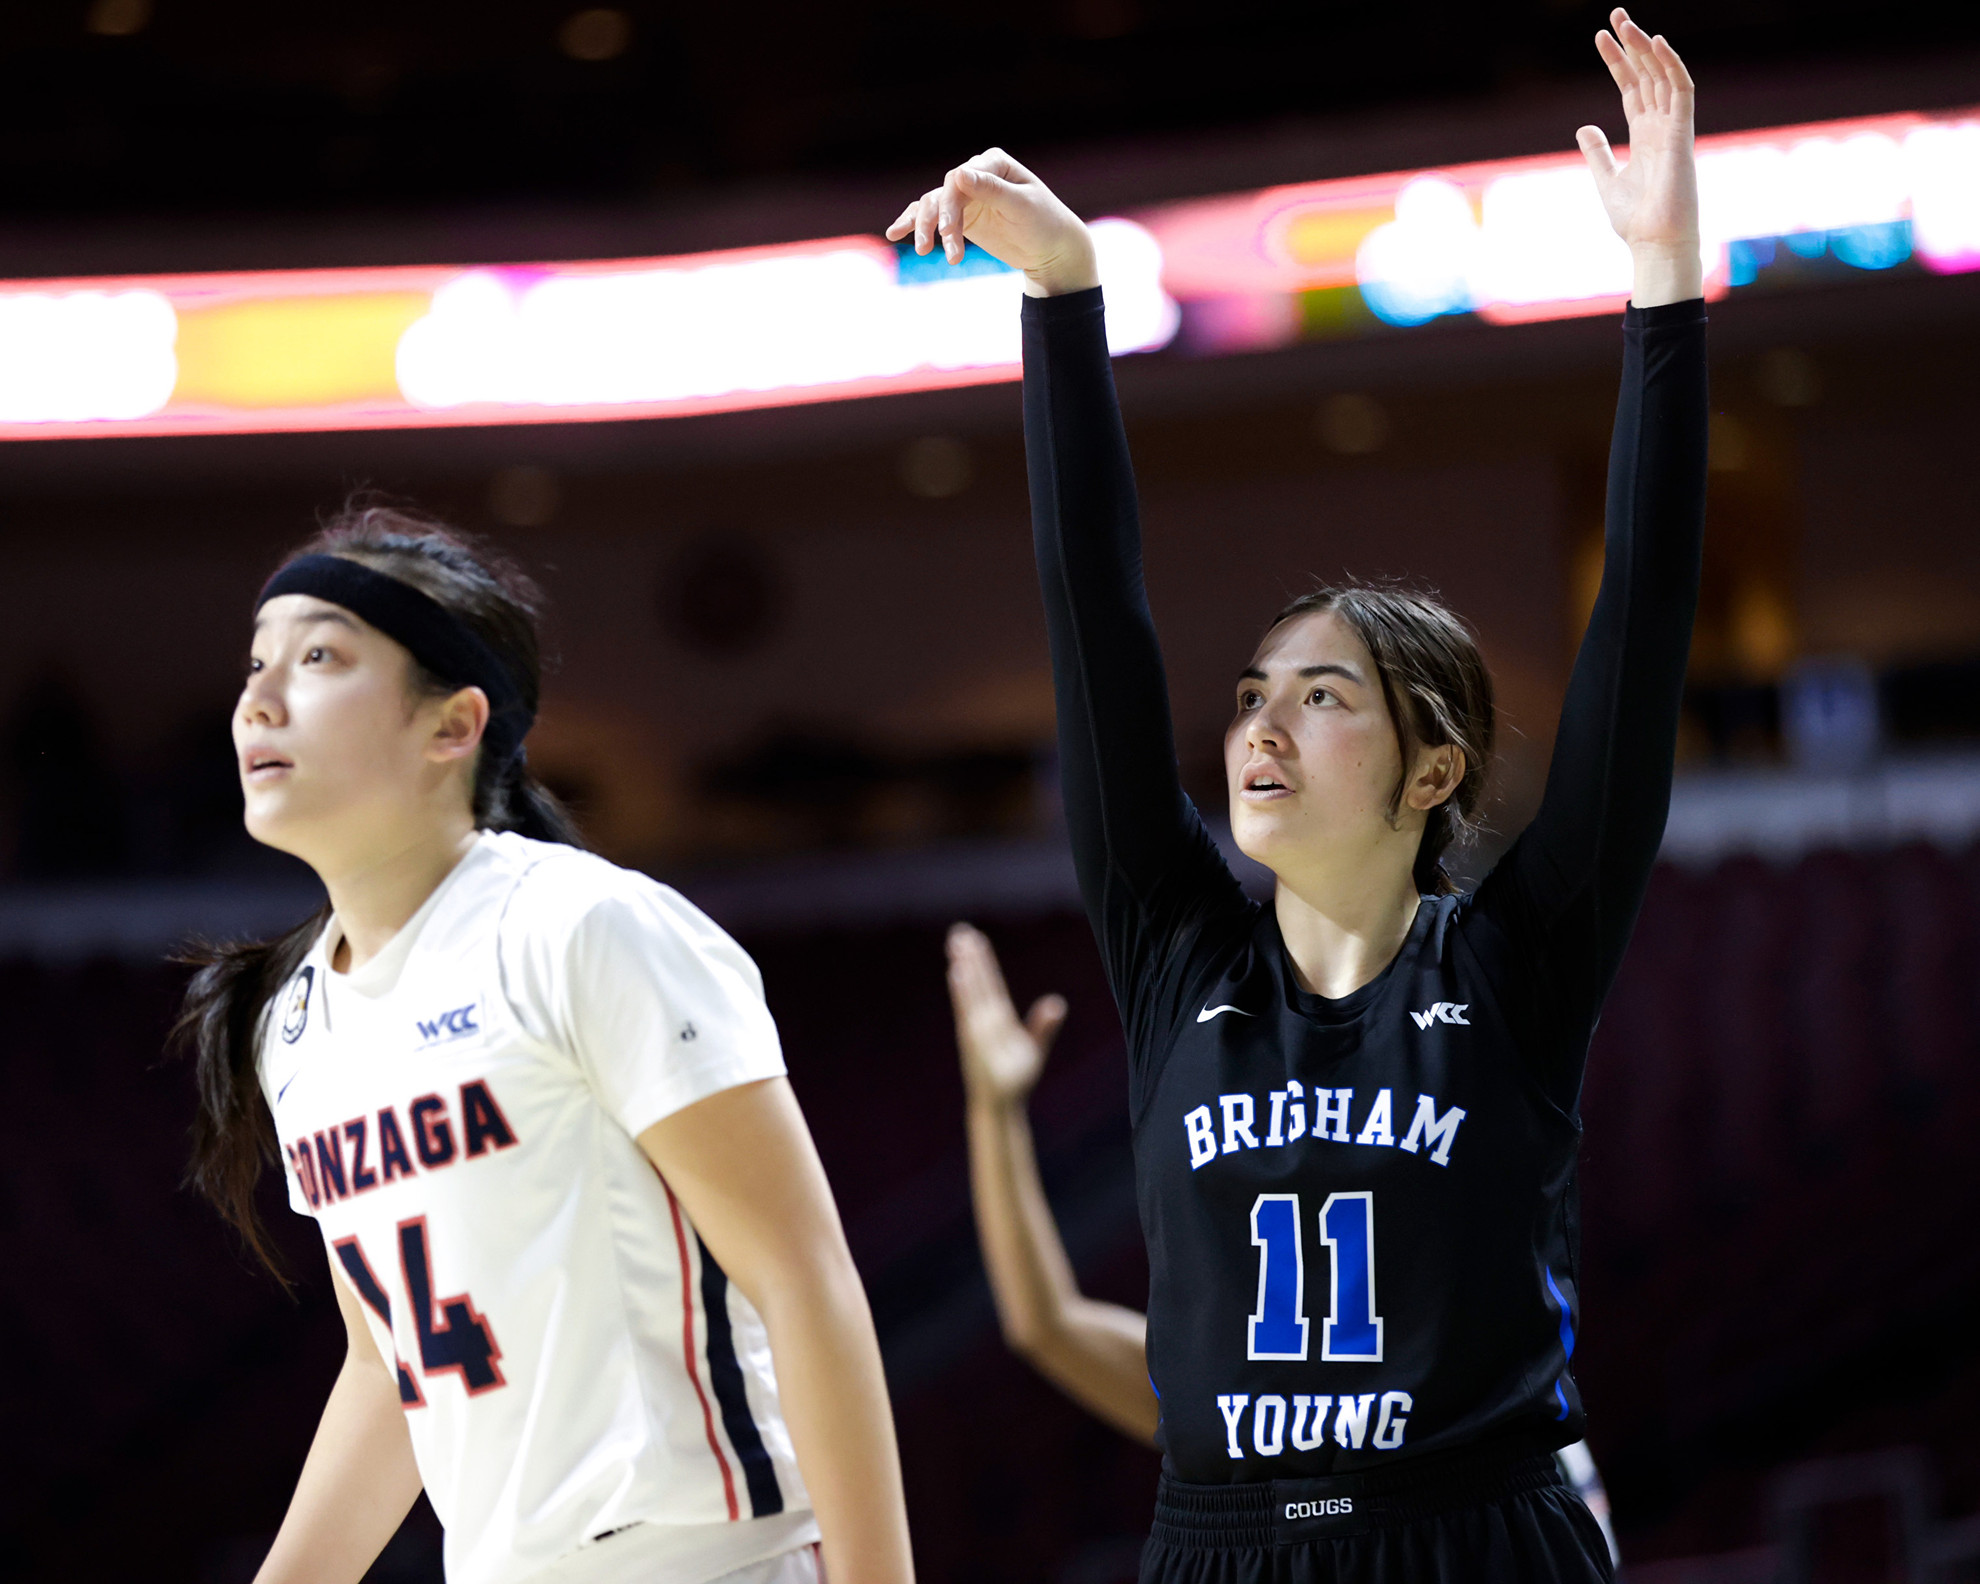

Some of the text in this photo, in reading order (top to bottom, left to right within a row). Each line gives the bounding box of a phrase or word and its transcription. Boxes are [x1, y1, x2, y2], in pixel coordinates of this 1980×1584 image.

[416, 1002, 479, 1041] WCC
[1409, 1001, 1471, 1031] WCC
[1183, 1079, 1468, 1171] BRIGHAM
[1247, 1190, 1384, 1363] 11
[331, 1213, 508, 1410] 14
[1217, 1390, 1413, 1459] YOUNG
[1284, 1497, 1353, 1520] COUGS
